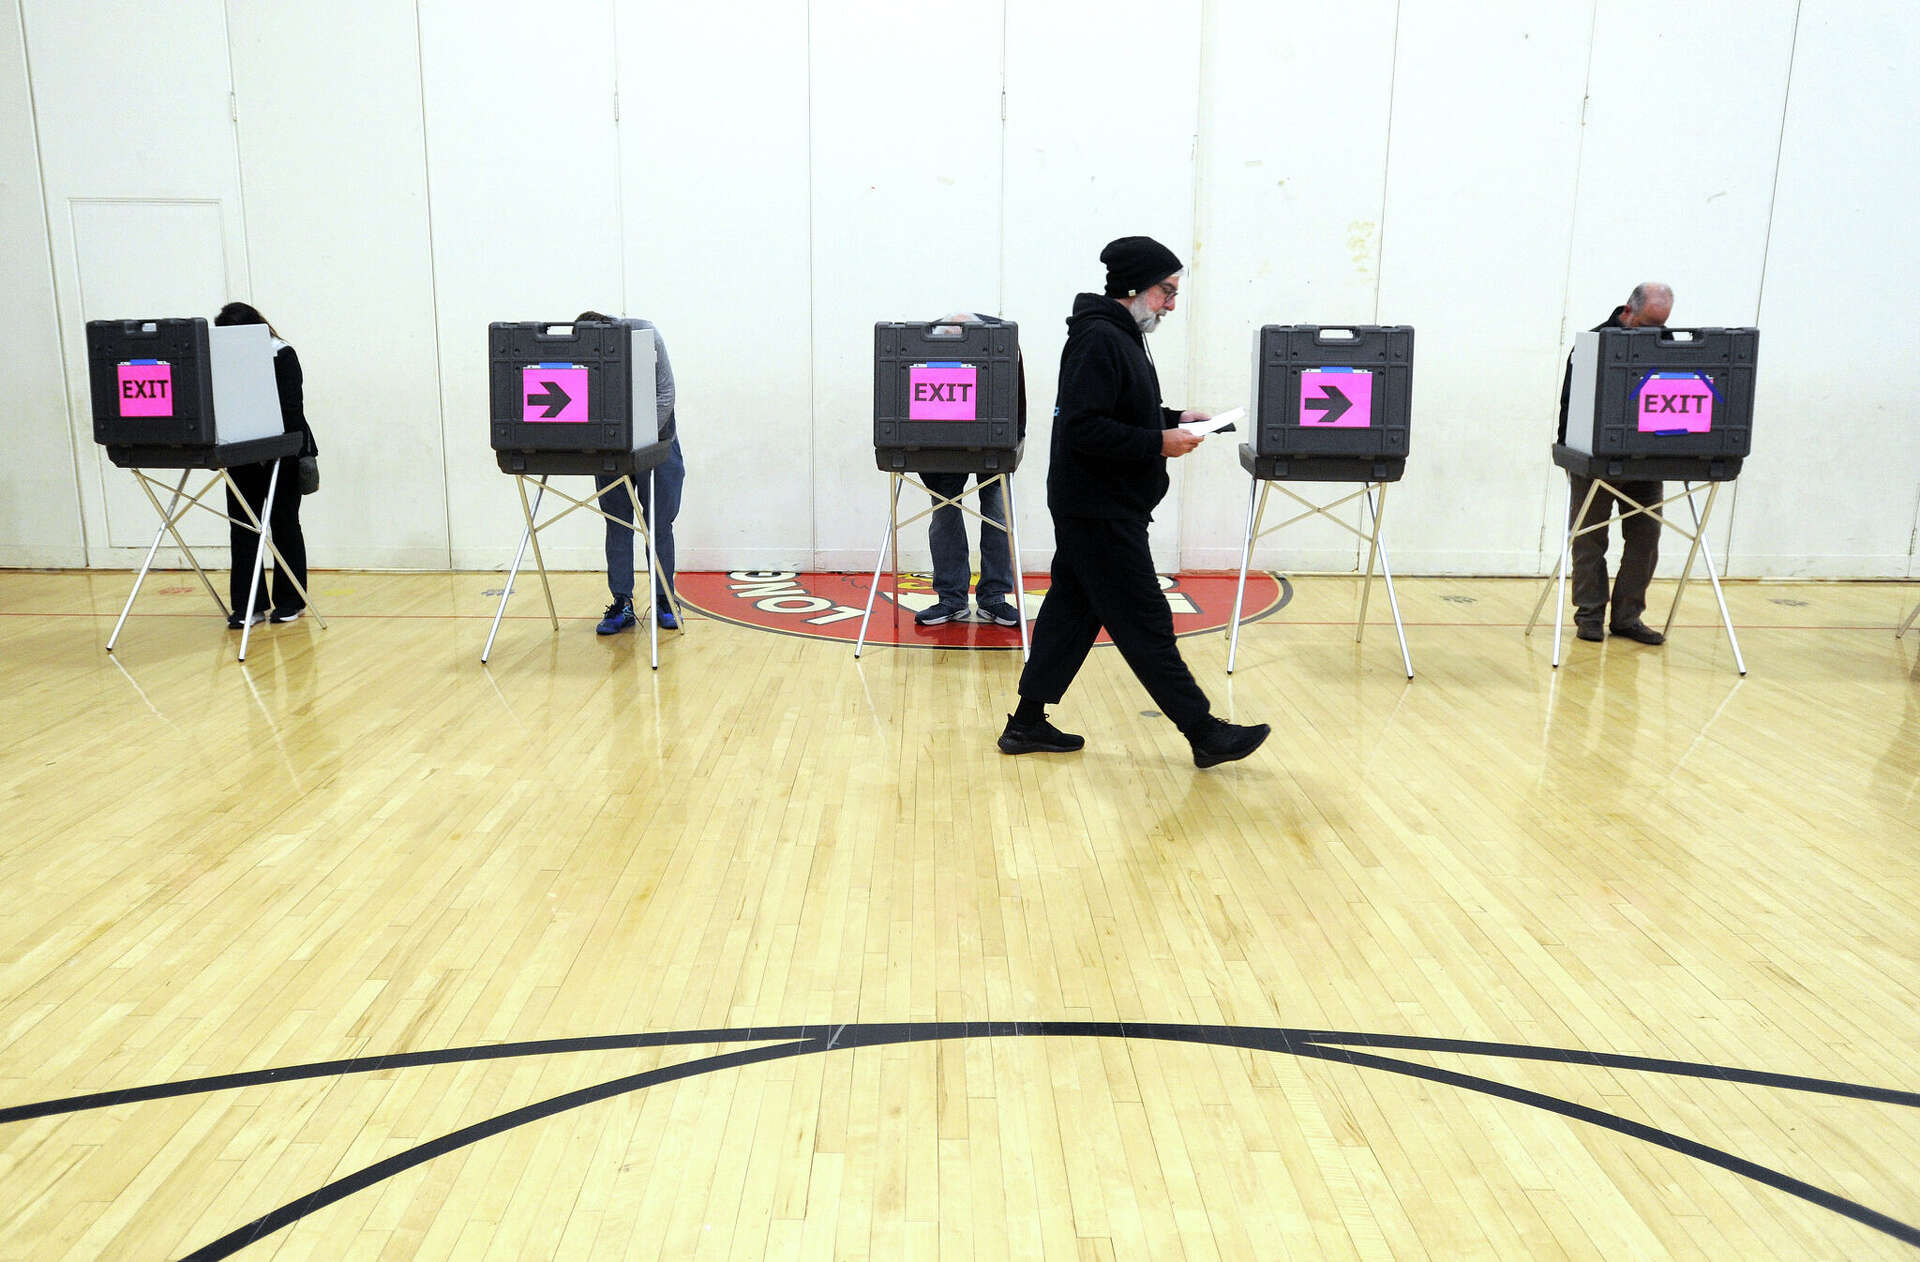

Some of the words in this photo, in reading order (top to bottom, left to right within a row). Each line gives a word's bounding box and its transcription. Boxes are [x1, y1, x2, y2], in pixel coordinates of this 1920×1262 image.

[122, 380, 169, 399] EXIT
[914, 383, 973, 402] EXIT
[1644, 394, 1708, 414] EXIT
